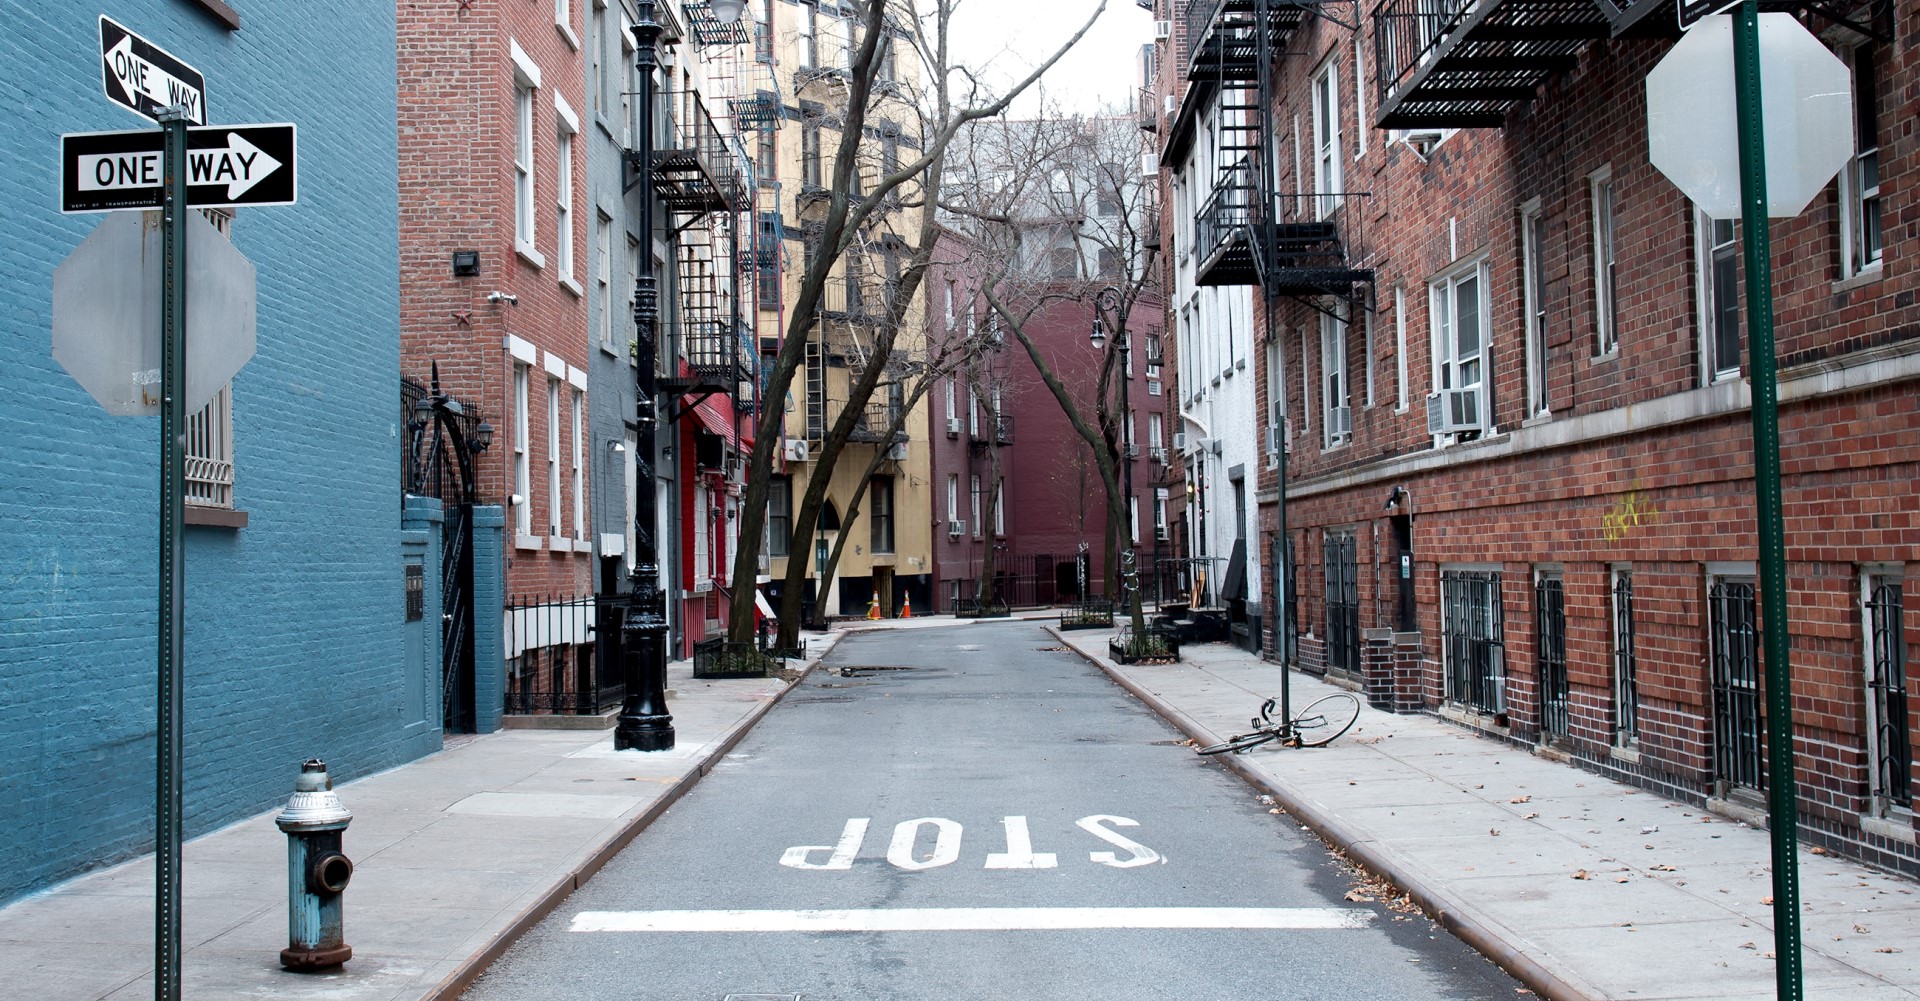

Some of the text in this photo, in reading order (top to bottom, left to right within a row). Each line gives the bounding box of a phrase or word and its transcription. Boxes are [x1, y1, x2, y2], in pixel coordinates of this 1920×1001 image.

[115, 49, 198, 118] ONE WAY
[95, 151, 258, 186] ONE WAY
[778, 814, 1168, 870] STOP
